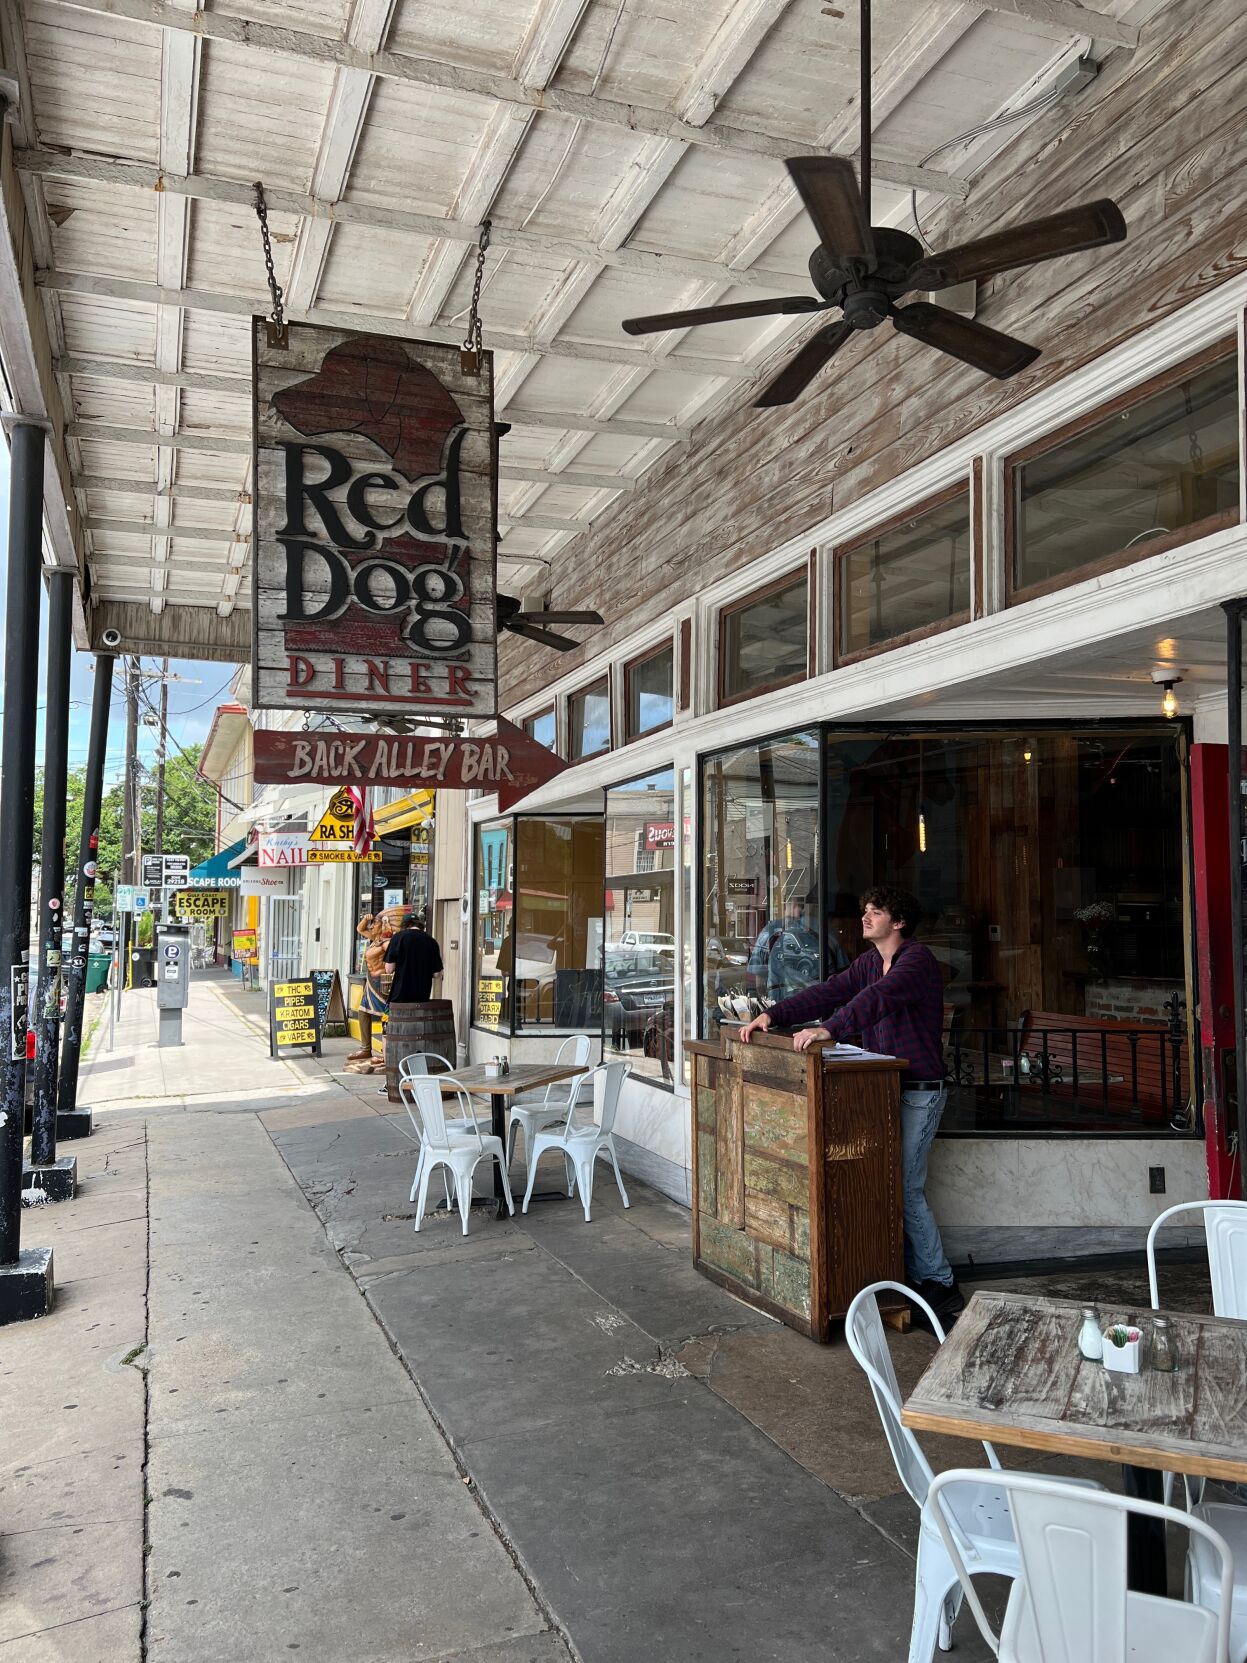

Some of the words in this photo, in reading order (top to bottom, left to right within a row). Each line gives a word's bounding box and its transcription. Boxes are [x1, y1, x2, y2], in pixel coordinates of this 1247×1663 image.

[275, 427, 470, 549] Red
[275, 538, 472, 652] Dog
[286, 654, 479, 697] DINER
[286, 738, 367, 779] BACK
[368, 742, 455, 780] ALLEY
[461, 742, 515, 783] BAR
[320, 824, 337, 839] RA
[339, 824, 355, 839] SH
[262, 847, 317, 865] NAIL
[318, 852, 345, 860] SMOKE
[346, 852, 352, 860] &
[187, 877, 216, 887] SCAPE
[261, 877, 278, 886] Shoe
[178, 897, 226, 908] ESCAPE
[287, 985, 301, 994] THC
[284, 997, 304, 1006] PIPES
[280, 1009, 310, 1018] KRATOM
[283, 1020, 309, 1030] CIGARS
[287, 1031, 306, 1041] VAPE
